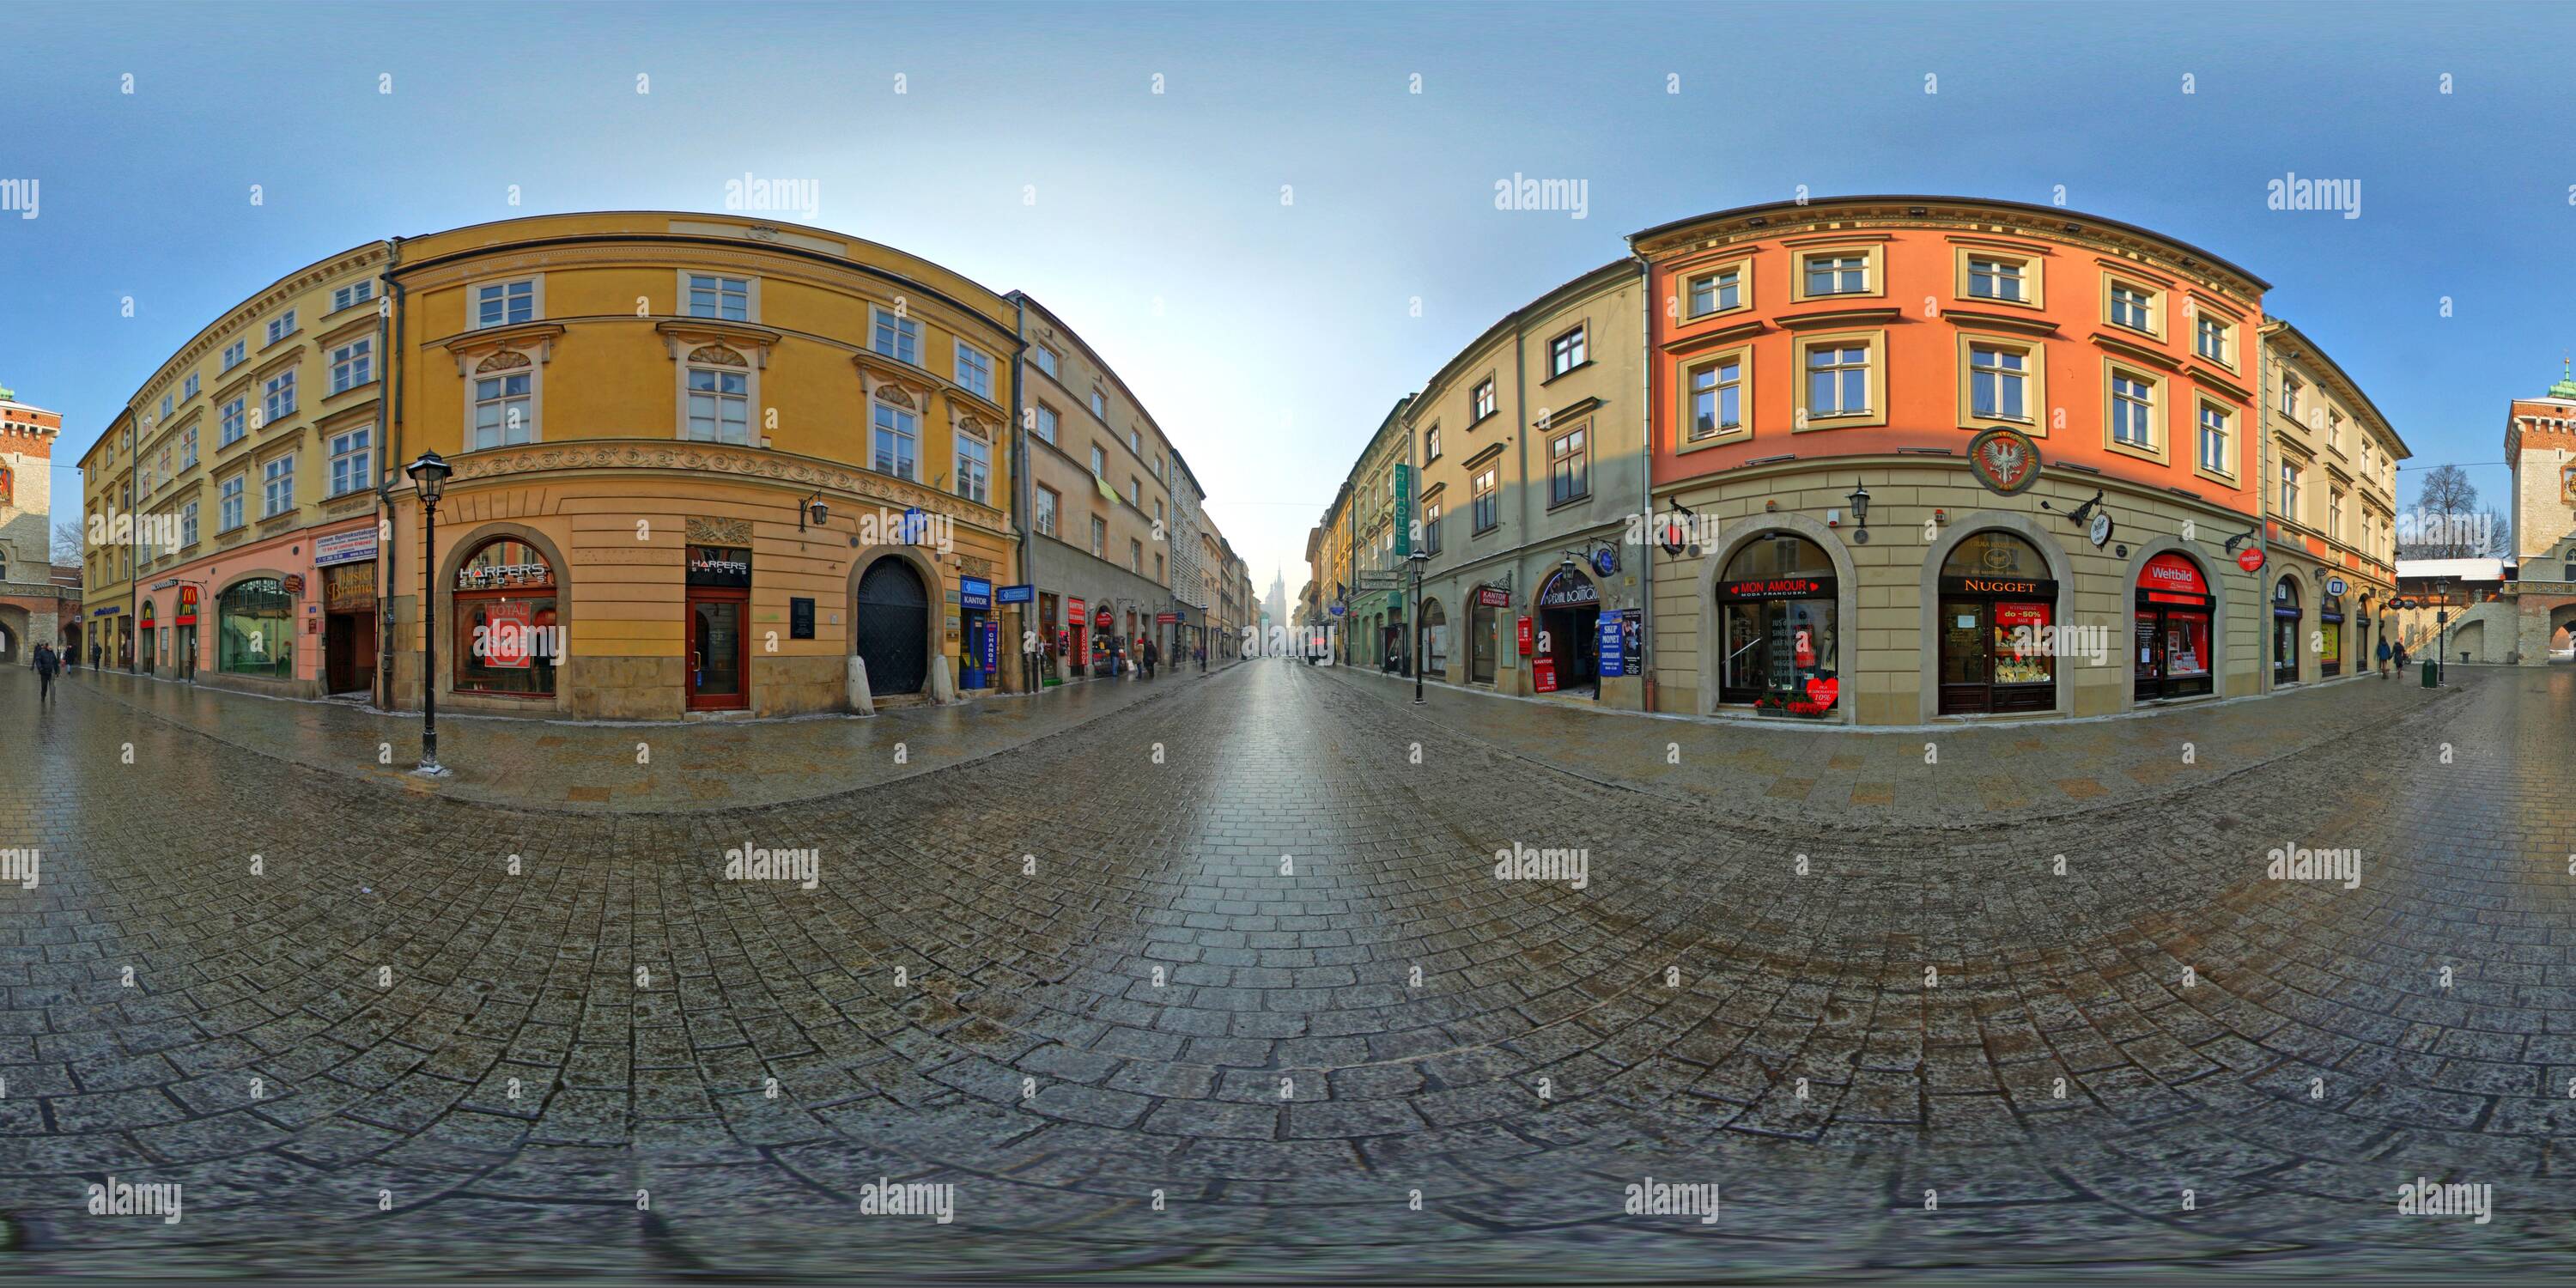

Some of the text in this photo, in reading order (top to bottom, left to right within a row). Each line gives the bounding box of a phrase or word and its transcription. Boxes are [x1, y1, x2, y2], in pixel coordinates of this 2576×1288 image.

[1396, 495, 1406, 547] HOTEL
[459, 562, 545, 579] HARPERS
[691, 560, 747, 570] HARPERS
[2152, 567, 2192, 582] Weltbild
[459, 575, 545, 586] SHOES
[1741, 580, 1807, 592] MON AMOUR
[1965, 579, 2037, 592] NUGGET
[964, 596, 987, 605] KANTOR
[1483, 591, 1506, 601] KANTOR
[1566, 588, 1600, 603] BOUTIQU
[490, 605, 526, 616] TOTAL
[1602, 635, 1619, 644] MONET
